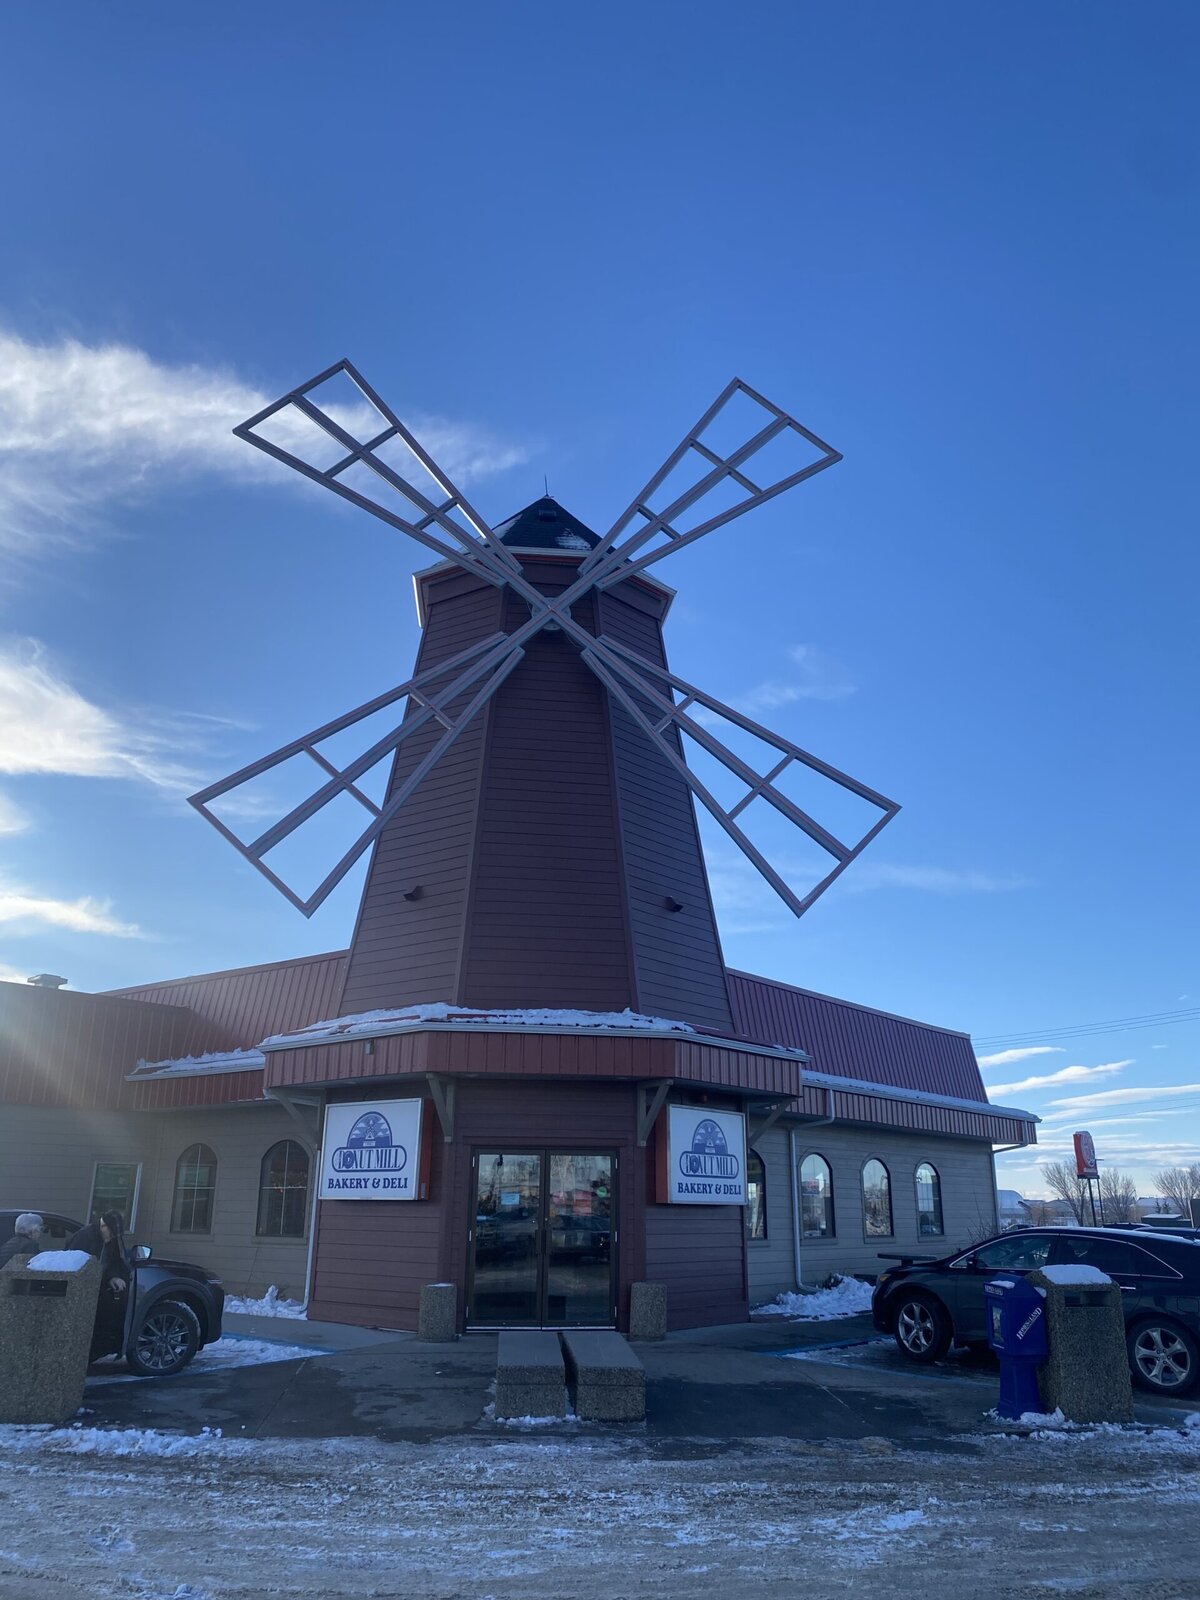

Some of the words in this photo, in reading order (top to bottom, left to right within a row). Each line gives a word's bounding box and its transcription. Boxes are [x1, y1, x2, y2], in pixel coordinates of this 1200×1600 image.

[338, 1149, 374, 1169] DONUT
[374, 1149, 400, 1168] MILL
[714, 1156, 735, 1176] MILL
[328, 1178, 370, 1189] BAKERY
[372, 1178, 380, 1189] &
[382, 1177, 408, 1188] DELI
[677, 1182, 713, 1194] BAKERY
[715, 1183, 722, 1194] &
[723, 1184, 741, 1195] DELI
